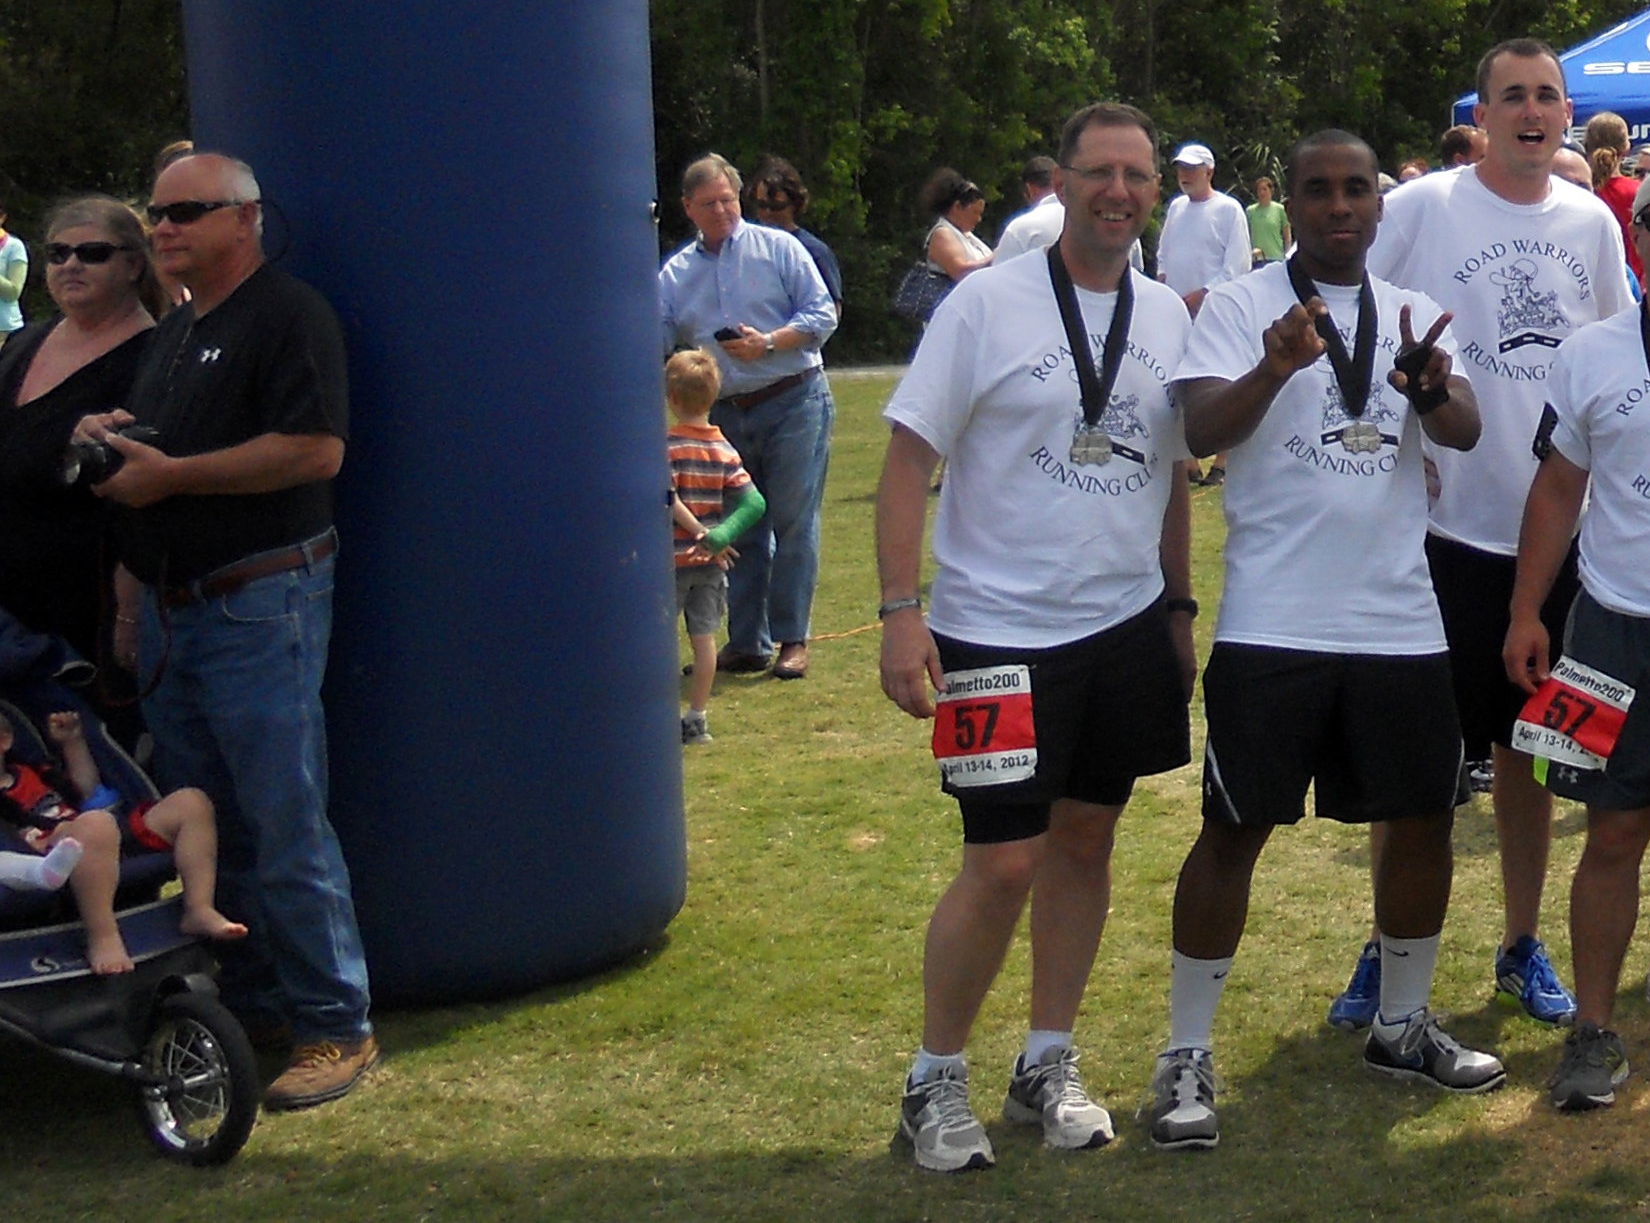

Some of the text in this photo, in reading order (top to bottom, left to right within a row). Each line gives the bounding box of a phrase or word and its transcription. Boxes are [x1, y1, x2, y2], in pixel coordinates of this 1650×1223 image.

[1454, 239, 1591, 301] ROAD WARRIORS
[1032, 345, 1071, 382] ROA
[1462, 340, 1546, 381] RUNNING
[1030, 445, 1121, 497] RUNNING
[1284, 434, 1375, 476] RUNNING
[939, 672, 1020, 696] almetto200
[1554, 661, 1625, 703] Palmetto200
[954, 703, 1001, 750] 57
[1518, 726, 1542, 742] April
[1543, 689, 1597, 738] 57
[1000, 754, 1029, 770] 2012
